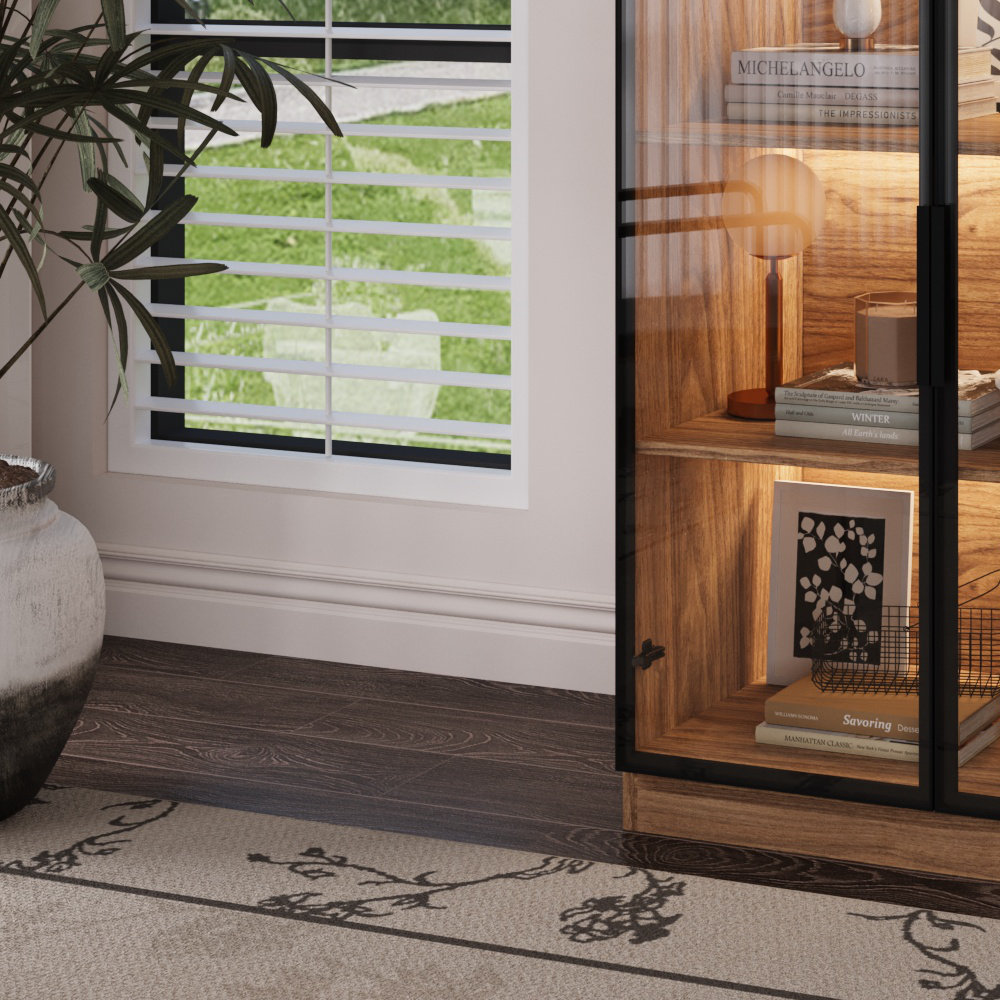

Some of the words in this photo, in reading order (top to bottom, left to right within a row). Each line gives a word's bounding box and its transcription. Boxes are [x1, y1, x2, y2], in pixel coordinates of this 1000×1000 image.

[737, 59, 866, 78] MICHELANGELO
[819, 109, 836, 118] THE
[839, 110, 917, 120] IMPRESSIONISTS
[851, 412, 891, 424] WINTER
[842, 428, 853, 437] All
[842, 714, 892, 733] Savoring
[897, 723, 919, 734] Desse
[784, 734, 826, 746] MANHATTAN
[826, 740, 853, 750] CLASSIC
